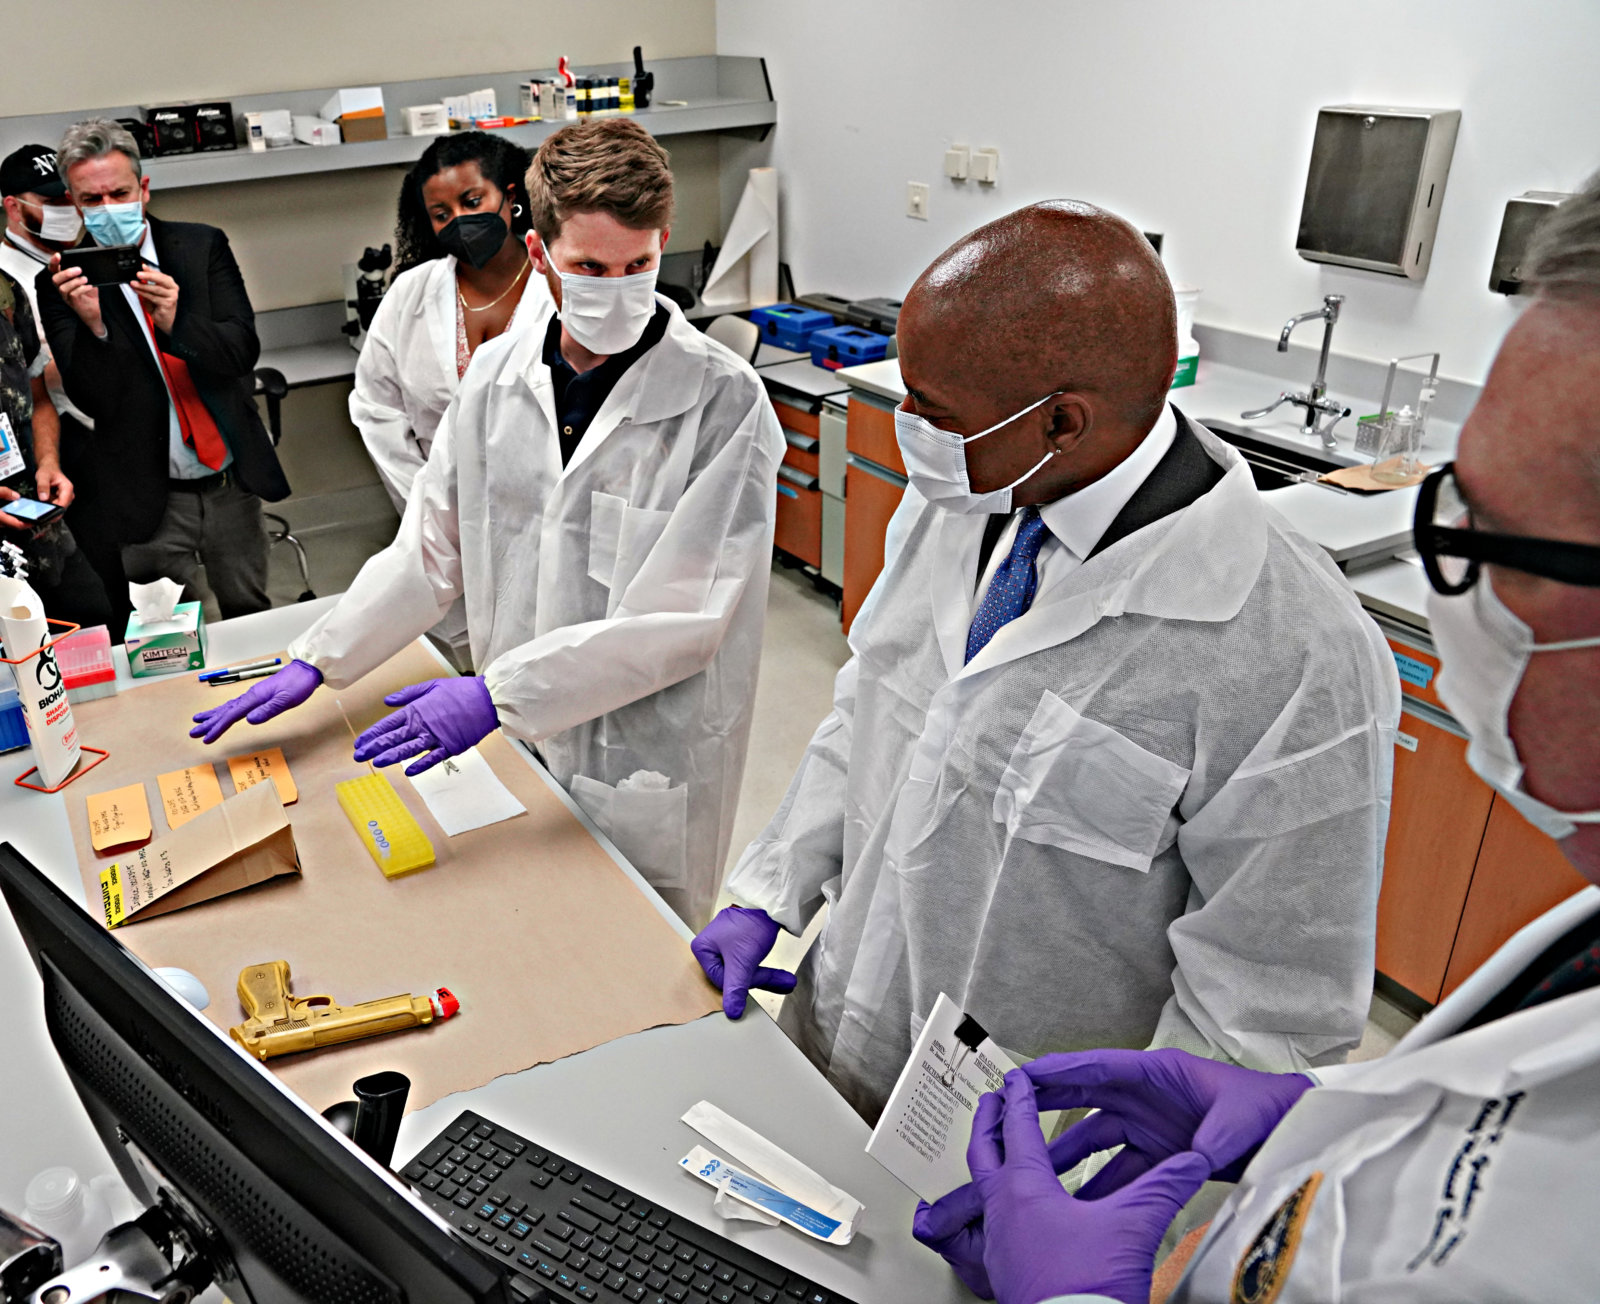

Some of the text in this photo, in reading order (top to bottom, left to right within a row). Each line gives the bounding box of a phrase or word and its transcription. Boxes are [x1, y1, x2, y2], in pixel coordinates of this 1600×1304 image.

[142, 647, 188, 659] KIMTECH
[38, 687, 64, 710] BIOHA
[46, 707, 69, 726] DISPOSA
[110, 865, 118, 885] EVIDENCE
